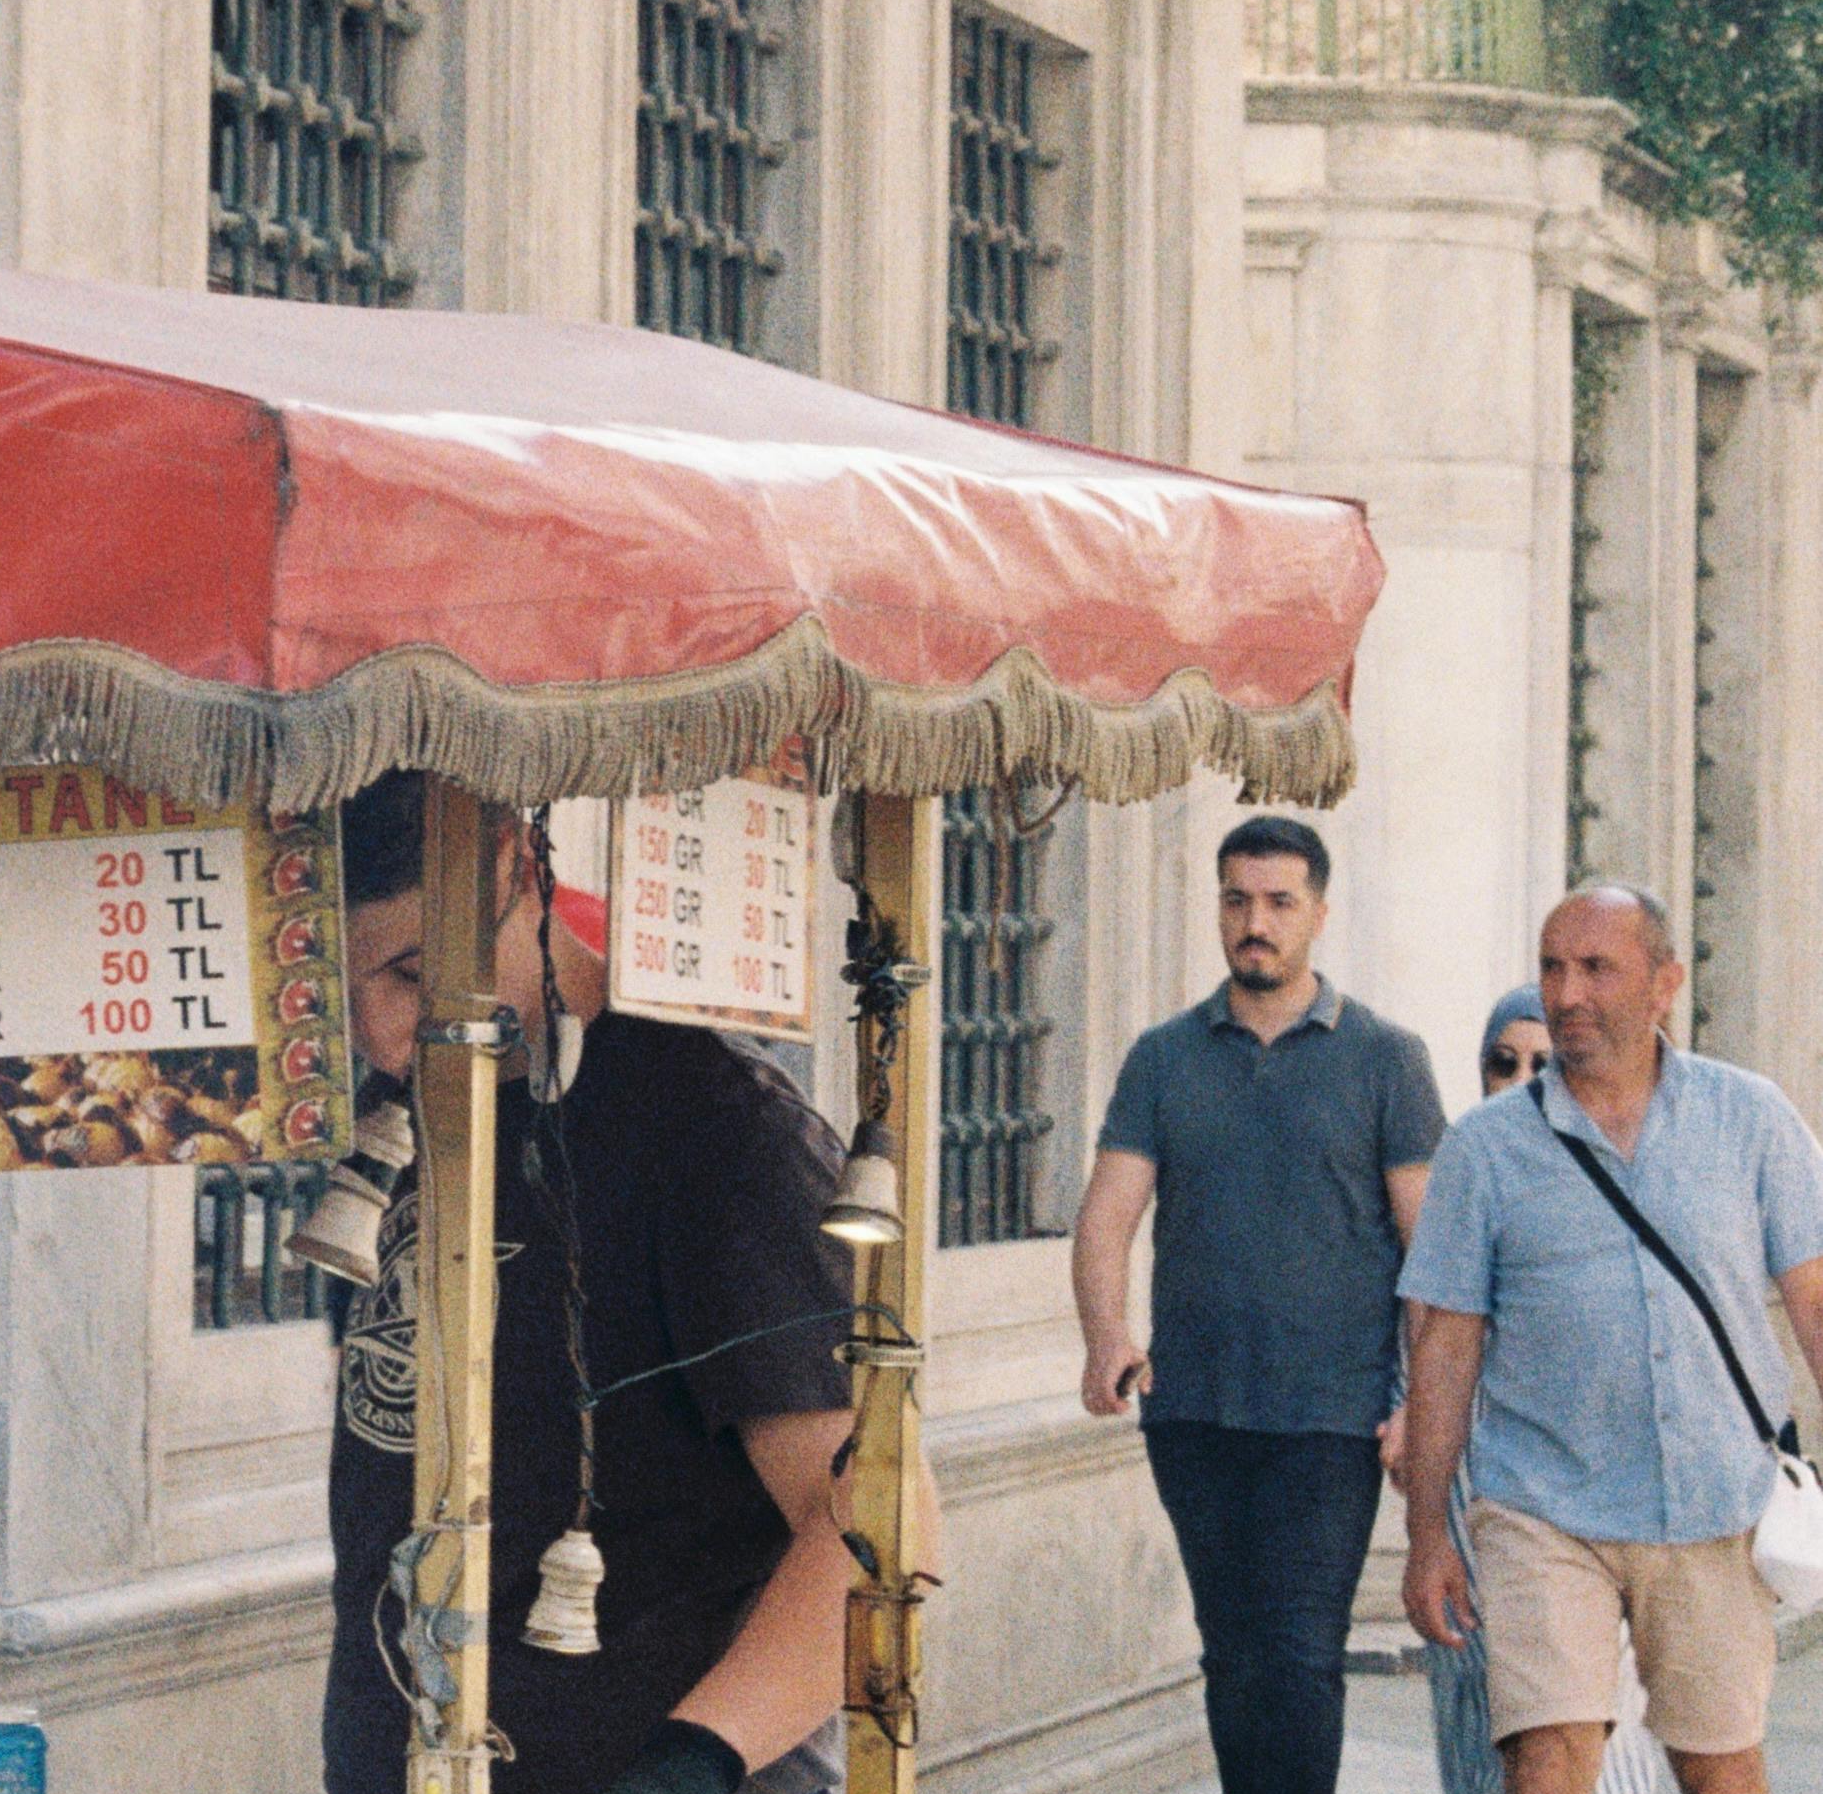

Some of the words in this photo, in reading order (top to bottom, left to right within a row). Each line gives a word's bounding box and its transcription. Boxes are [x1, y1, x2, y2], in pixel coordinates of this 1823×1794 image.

[774, 805, 796, 847] TL
[95, 851, 146, 888] 20
[164, 847, 220, 884] TL
[636, 824, 669, 866] 150
[674, 832, 705, 875] GR
[773, 857, 795, 898] TL
[98, 900, 148, 937] 30
[166, 896, 223, 932] TL
[634, 877, 668, 920] 250
[673, 886, 702, 928] GR
[771, 909, 794, 949] TL
[100, 949, 150, 986] 50
[168, 945, 225, 981] TL
[672, 940, 702, 980] GR
[770, 961, 793, 1001] TL
[79, 997, 152, 1036] 100
[170, 995, 228, 1031] TL
